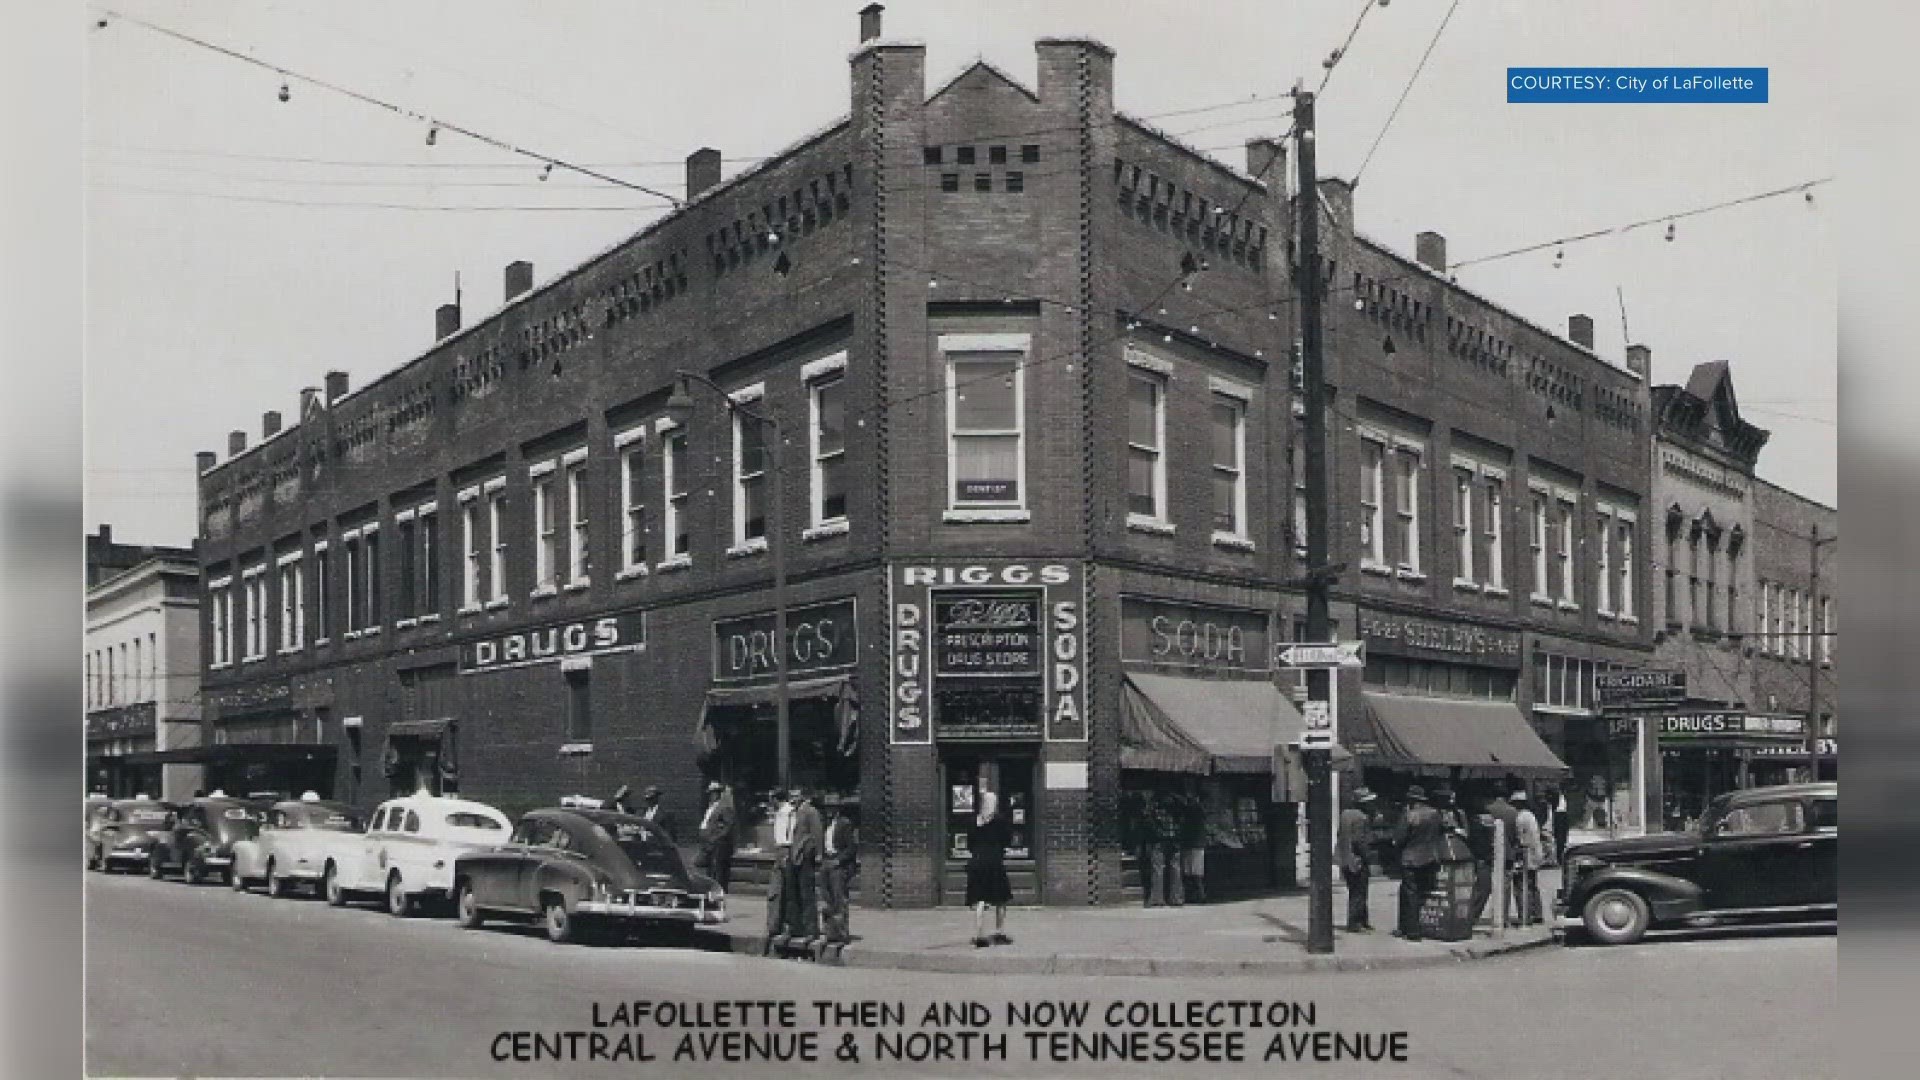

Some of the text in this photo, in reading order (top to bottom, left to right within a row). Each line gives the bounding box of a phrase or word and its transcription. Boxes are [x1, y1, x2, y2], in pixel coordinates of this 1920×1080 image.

[903, 565, 1071, 585] RIGGS
[476, 618, 618, 665] DRUGS
[730, 618, 833, 670] DRUGS
[1053, 601, 1080, 722] SODA
[1152, 615, 1245, 663] SODA
[897, 603, 922, 729] DRUGS
[1667, 714, 1725, 732] DRUGS
